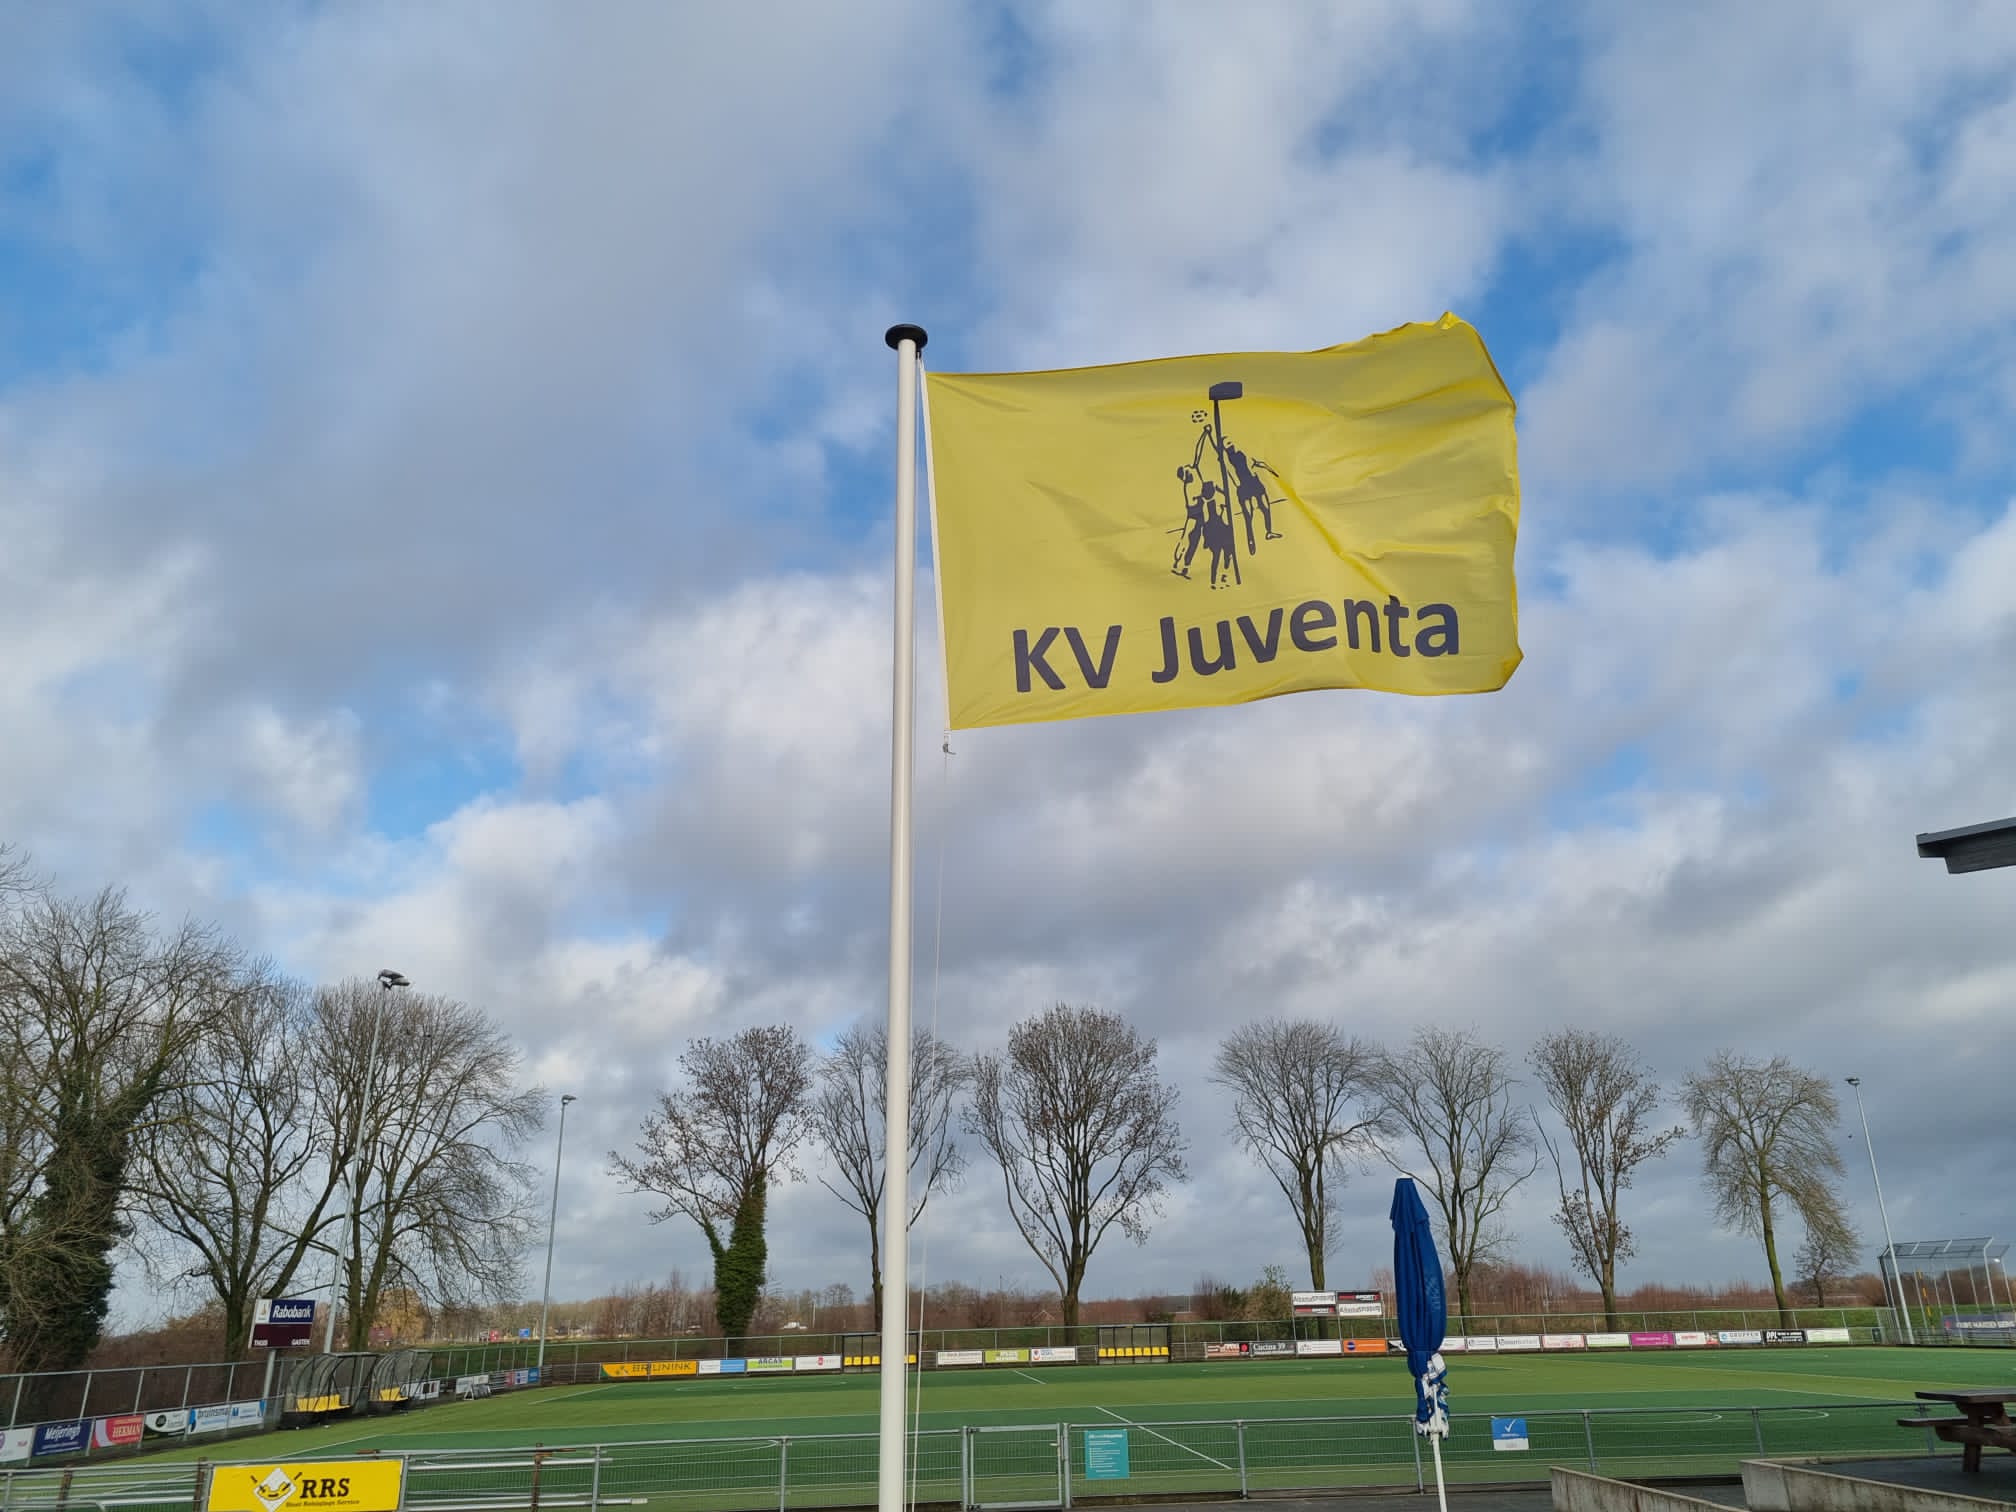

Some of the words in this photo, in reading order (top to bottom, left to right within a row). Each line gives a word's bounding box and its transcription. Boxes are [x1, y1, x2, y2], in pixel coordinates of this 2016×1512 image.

[1013, 625, 1122, 693] KV
[1152, 595, 1460, 684] Juventa
[273, 1304, 312, 1319] Rabobank
[300, 1478, 350, 1498] RRS
